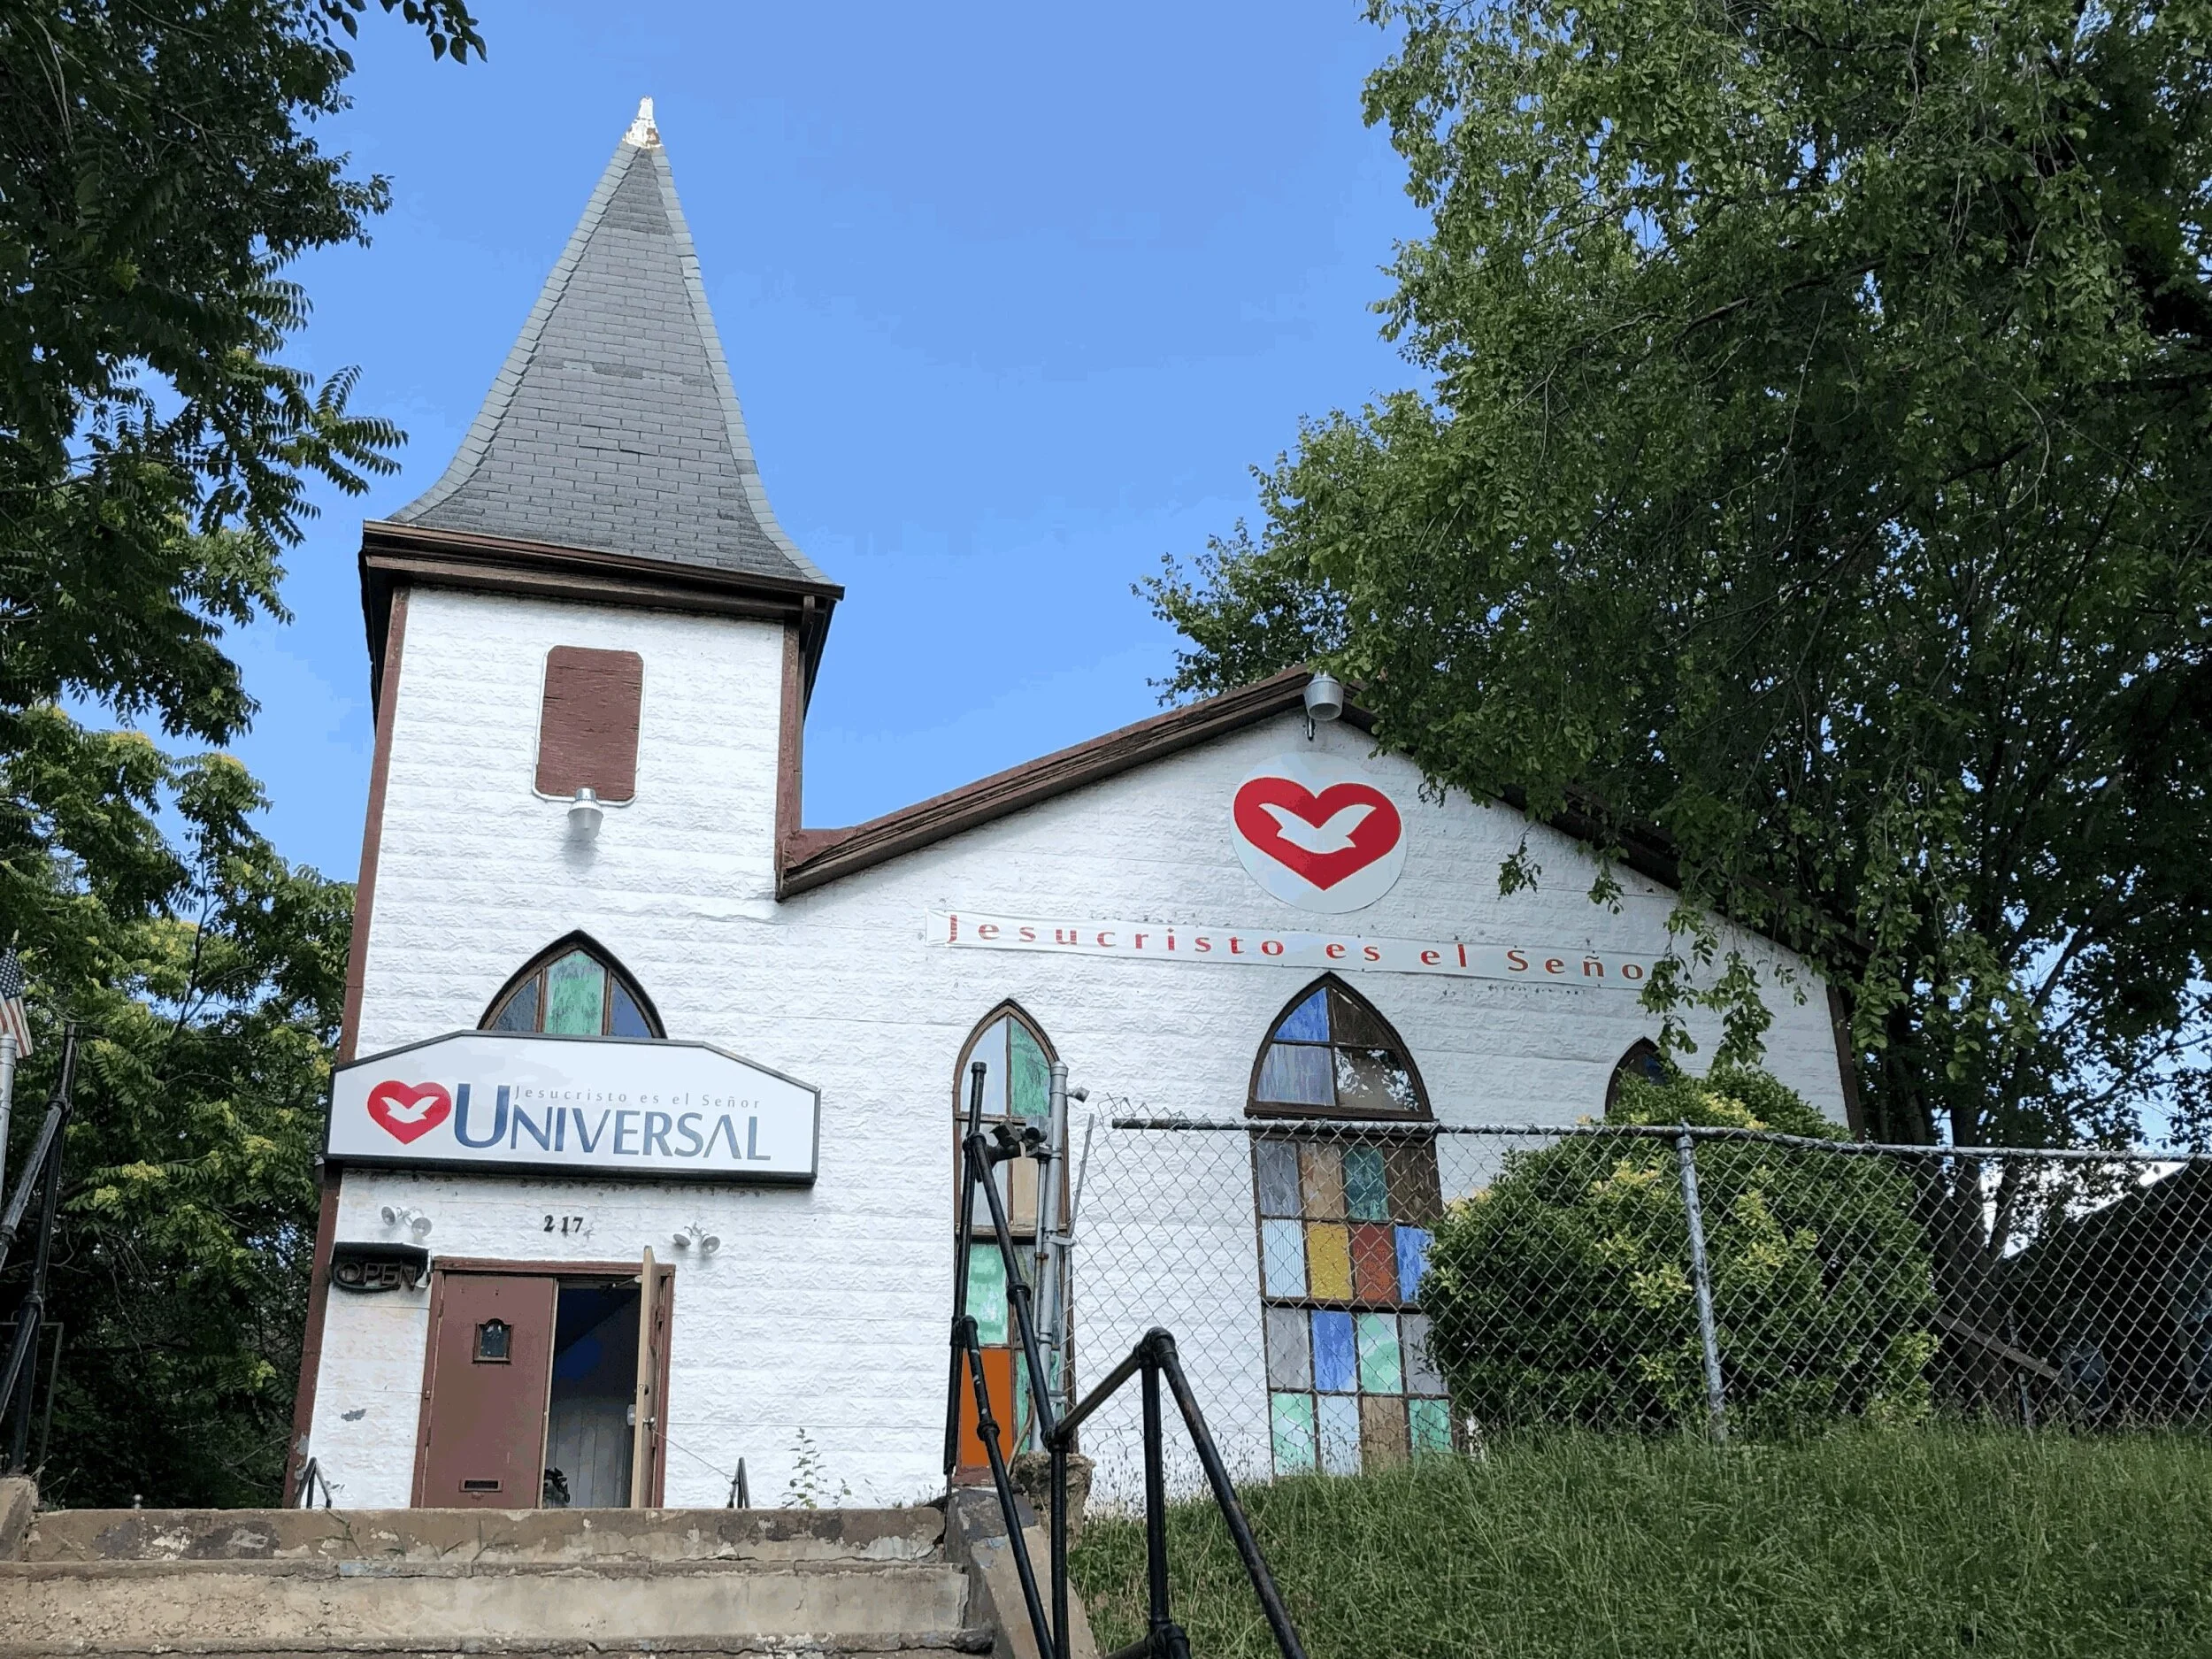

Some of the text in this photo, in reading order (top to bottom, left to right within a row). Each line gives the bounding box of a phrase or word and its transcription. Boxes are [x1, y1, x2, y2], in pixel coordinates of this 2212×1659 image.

[946, 914, 1645, 980] Jesucristo es el Seño
[515, 1085, 761, 1109] Jesucristo es el Señor
[454, 1082, 772, 1162] UNIVERSAL
[543, 1214, 585, 1236] 217
[338, 1262, 418, 1288] OPEN
